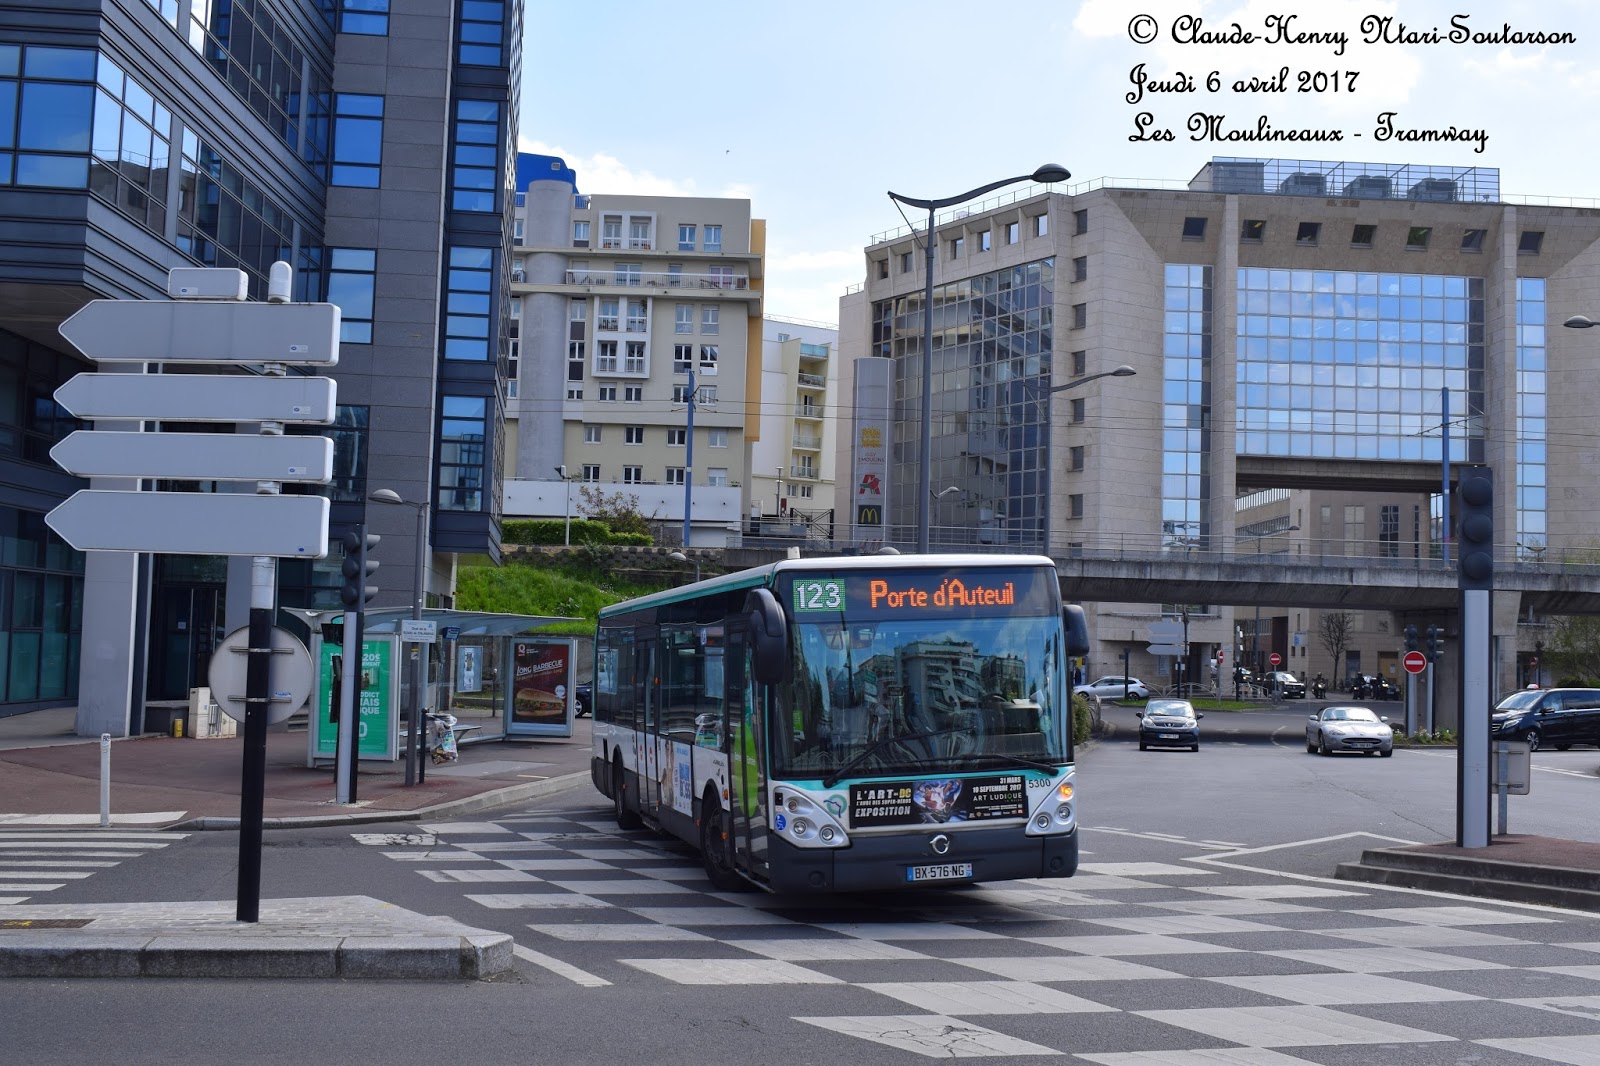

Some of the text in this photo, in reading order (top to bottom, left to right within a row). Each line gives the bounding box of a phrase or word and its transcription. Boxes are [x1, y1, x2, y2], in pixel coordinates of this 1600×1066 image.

[797, 578, 1014, 609] 123 Porte d'Auteuil
[516, 665, 532, 676] LONG
[533, 659, 563, 672] BARBECUE
[1007, 776, 1022, 784] MARS
[1028, 778, 1051, 788] 5300
[856, 789, 894, 800] L'ART
[899, 788, 912, 798] DC
[980, 785, 1008, 793] SEPTEMBRE
[990, 792, 1022, 800] LUDIQUE
[855, 806, 911, 817] EXPOSITION
[915, 865, 965, 879] BX-576-NG
